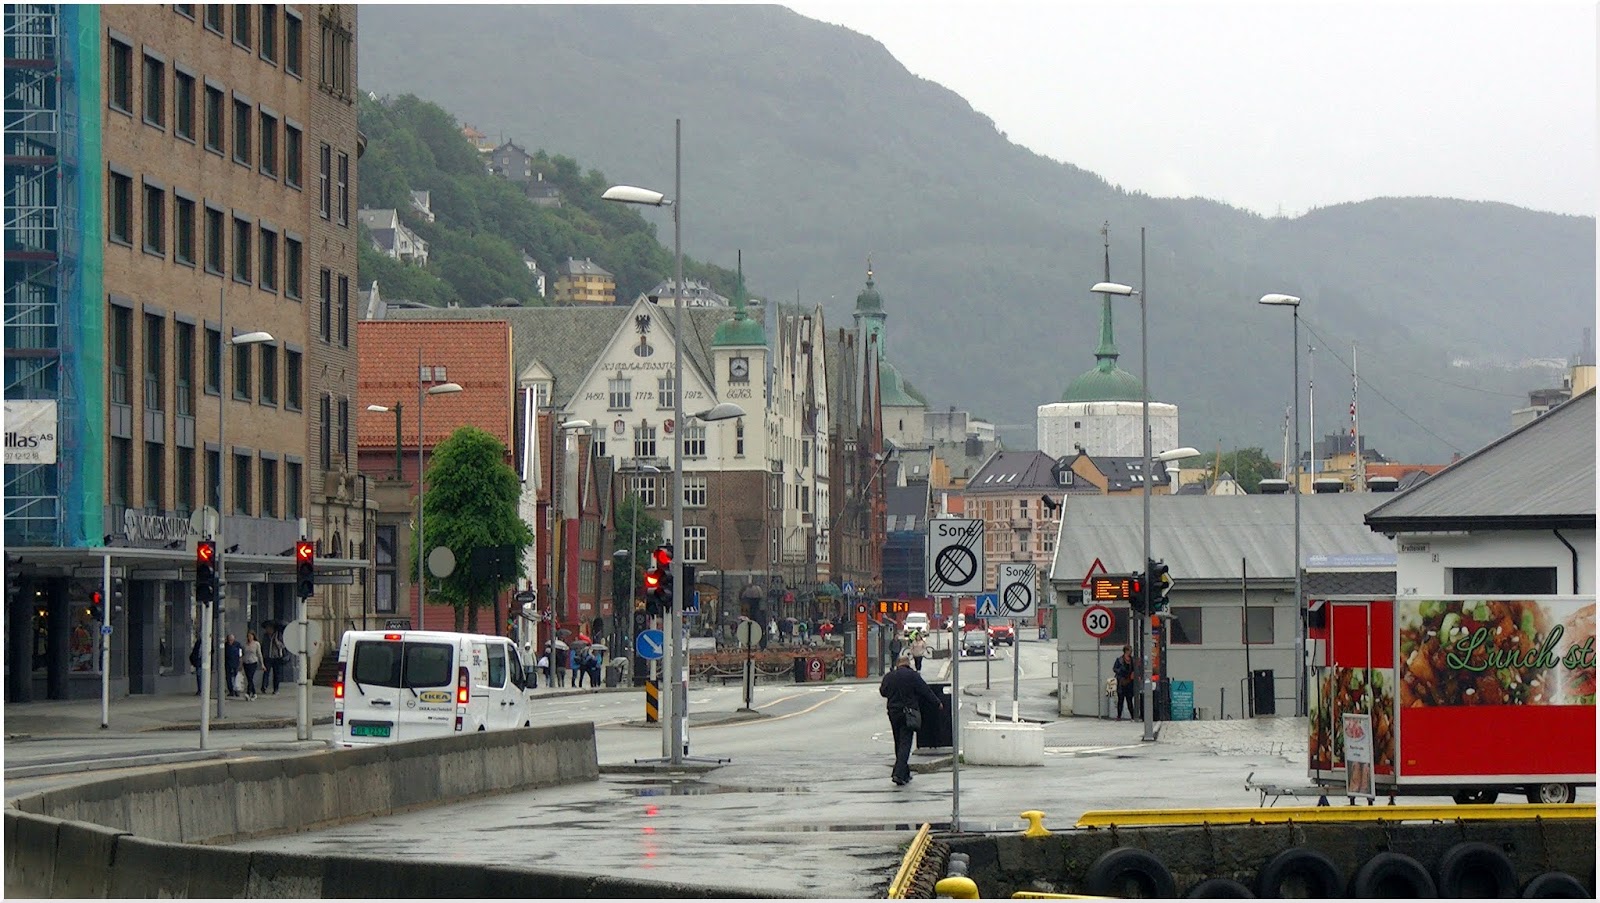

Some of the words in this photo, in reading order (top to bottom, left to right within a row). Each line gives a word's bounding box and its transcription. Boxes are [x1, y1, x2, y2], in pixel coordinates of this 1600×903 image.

[40, 433, 54, 441] AS
[938, 523, 975, 537] Sone
[1005, 566, 1031, 577] Sone
[1089, 614, 1109, 630] 30
[1446, 624, 1565, 672] Lunch
[1562, 636, 1596, 669] st
[424, 692, 449, 700] IKEA
